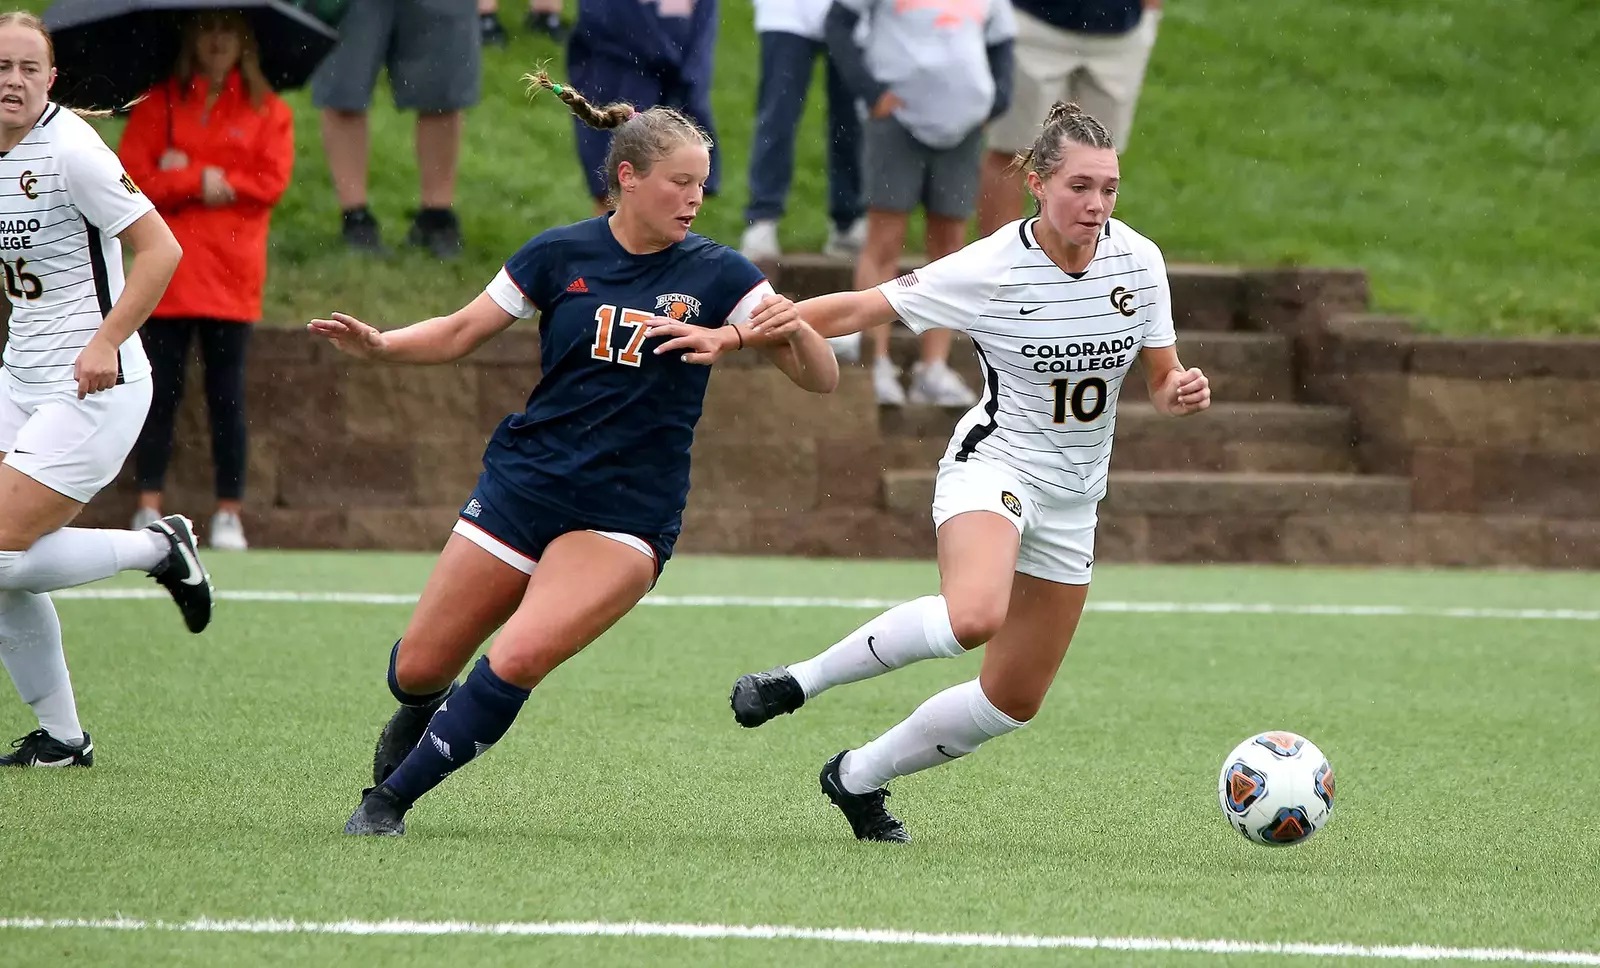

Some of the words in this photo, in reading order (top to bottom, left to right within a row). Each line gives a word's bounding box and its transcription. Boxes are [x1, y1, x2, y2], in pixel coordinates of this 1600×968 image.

[590, 303, 655, 368] 17
[1020, 335, 1135, 359] COLORADO
[1033, 354, 1126, 373] COLLEGE
[1049, 376, 1108, 425] 10
